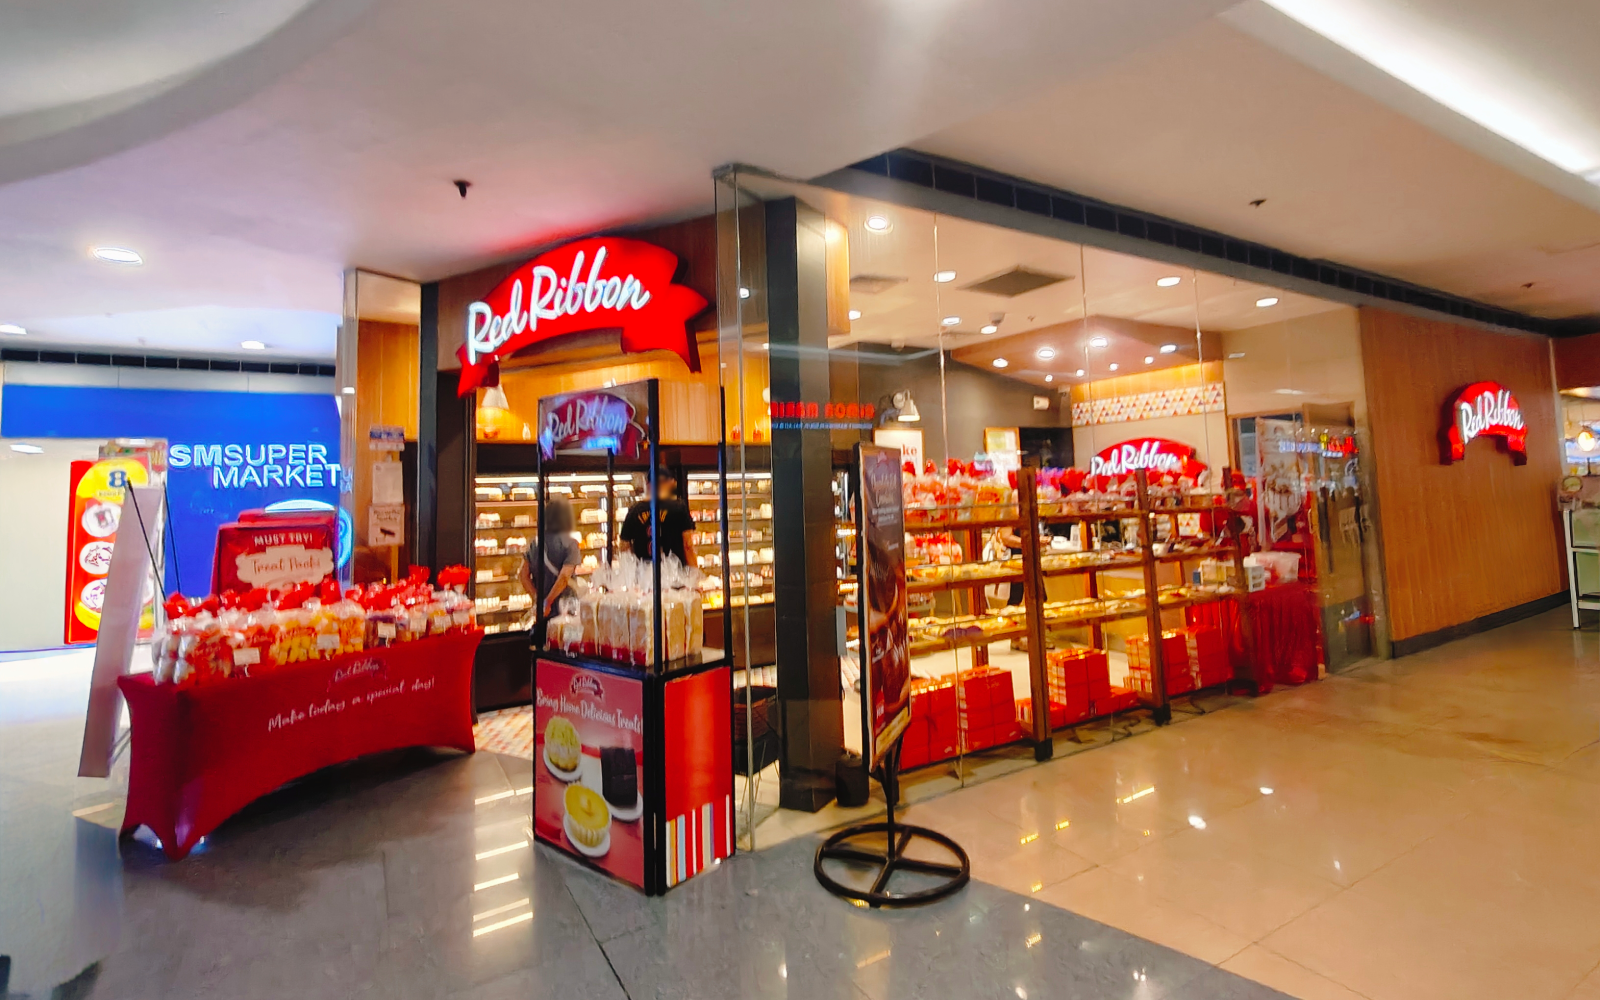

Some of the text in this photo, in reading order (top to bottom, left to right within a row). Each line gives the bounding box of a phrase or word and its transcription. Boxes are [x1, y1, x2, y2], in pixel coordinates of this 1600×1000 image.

[468, 246, 651, 366] Red Ribbon
[1460, 388, 1524, 445] Red Ribbon
[109, 470, 126, 487] 8
[213, 464, 341, 489] MARKET
[268, 708, 305, 732] Make
[536, 687, 559, 712] Bring
[560, 693, 580, 714] Home
[581, 699, 616, 727] Delicious
